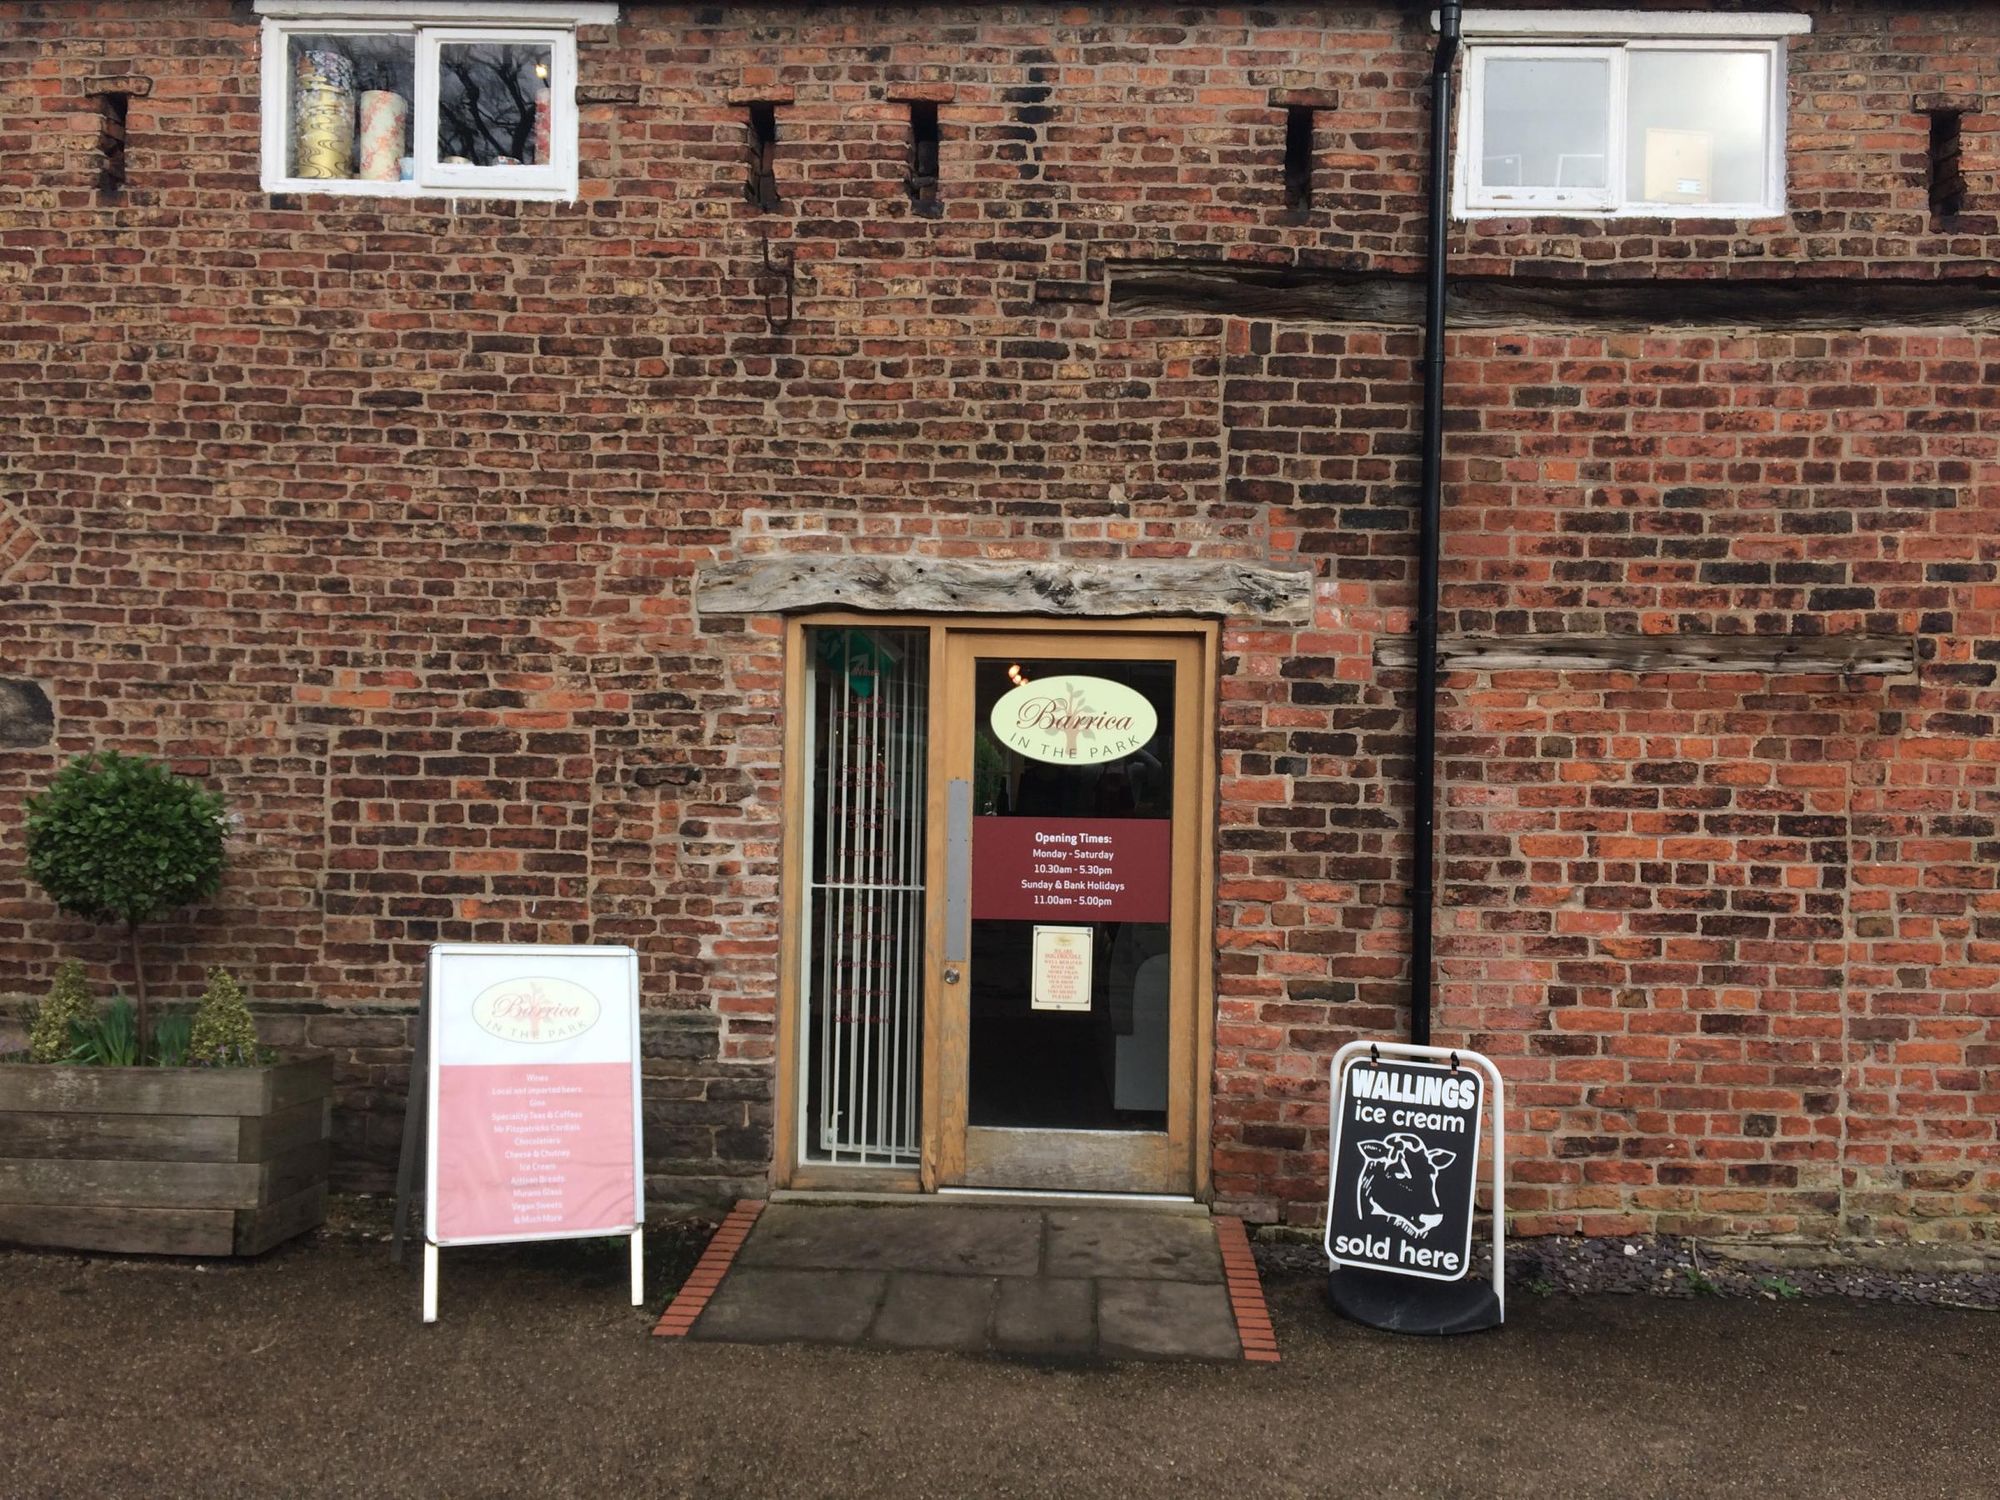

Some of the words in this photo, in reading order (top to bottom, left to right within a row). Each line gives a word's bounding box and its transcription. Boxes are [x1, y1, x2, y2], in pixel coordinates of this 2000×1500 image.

[1016, 696, 1135, 731] Barrica
[1010, 732, 1031, 749] IN
[1041, 743, 1077, 759] THE
[1090, 735, 1141, 758] PARK
[1035, 832, 1077, 845] Opening
[1079, 833, 1112, 844] Times:
[1033, 848, 1067, 860] Monday
[1074, 849, 1114, 861] Saturday
[1034, 864, 1072, 874] 10.30am
[1079, 865, 1112, 876] 5.30pm
[1021, 879, 1054, 890] Sunday
[1055, 880, 1062, 889] &
[1063, 880, 1086, 890] Bank
[1087, 881, 1125, 892] Holidays
[1034, 895, 1072, 905] 11.00am
[1079, 896, 1112, 907] 5.00pm
[491, 993, 581, 1018] Barrica
[486, 1020, 502, 1033] IN
[511, 1028, 540, 1040] THE
[548, 1020, 588, 1038] PARK
[1352, 1068, 1476, 1110] WALLINGS
[1355, 1100, 1387, 1124] ice
[1392, 1109, 1465, 1133] cream
[1335, 1234, 1390, 1261] sold
[1400, 1239, 1459, 1271] here
